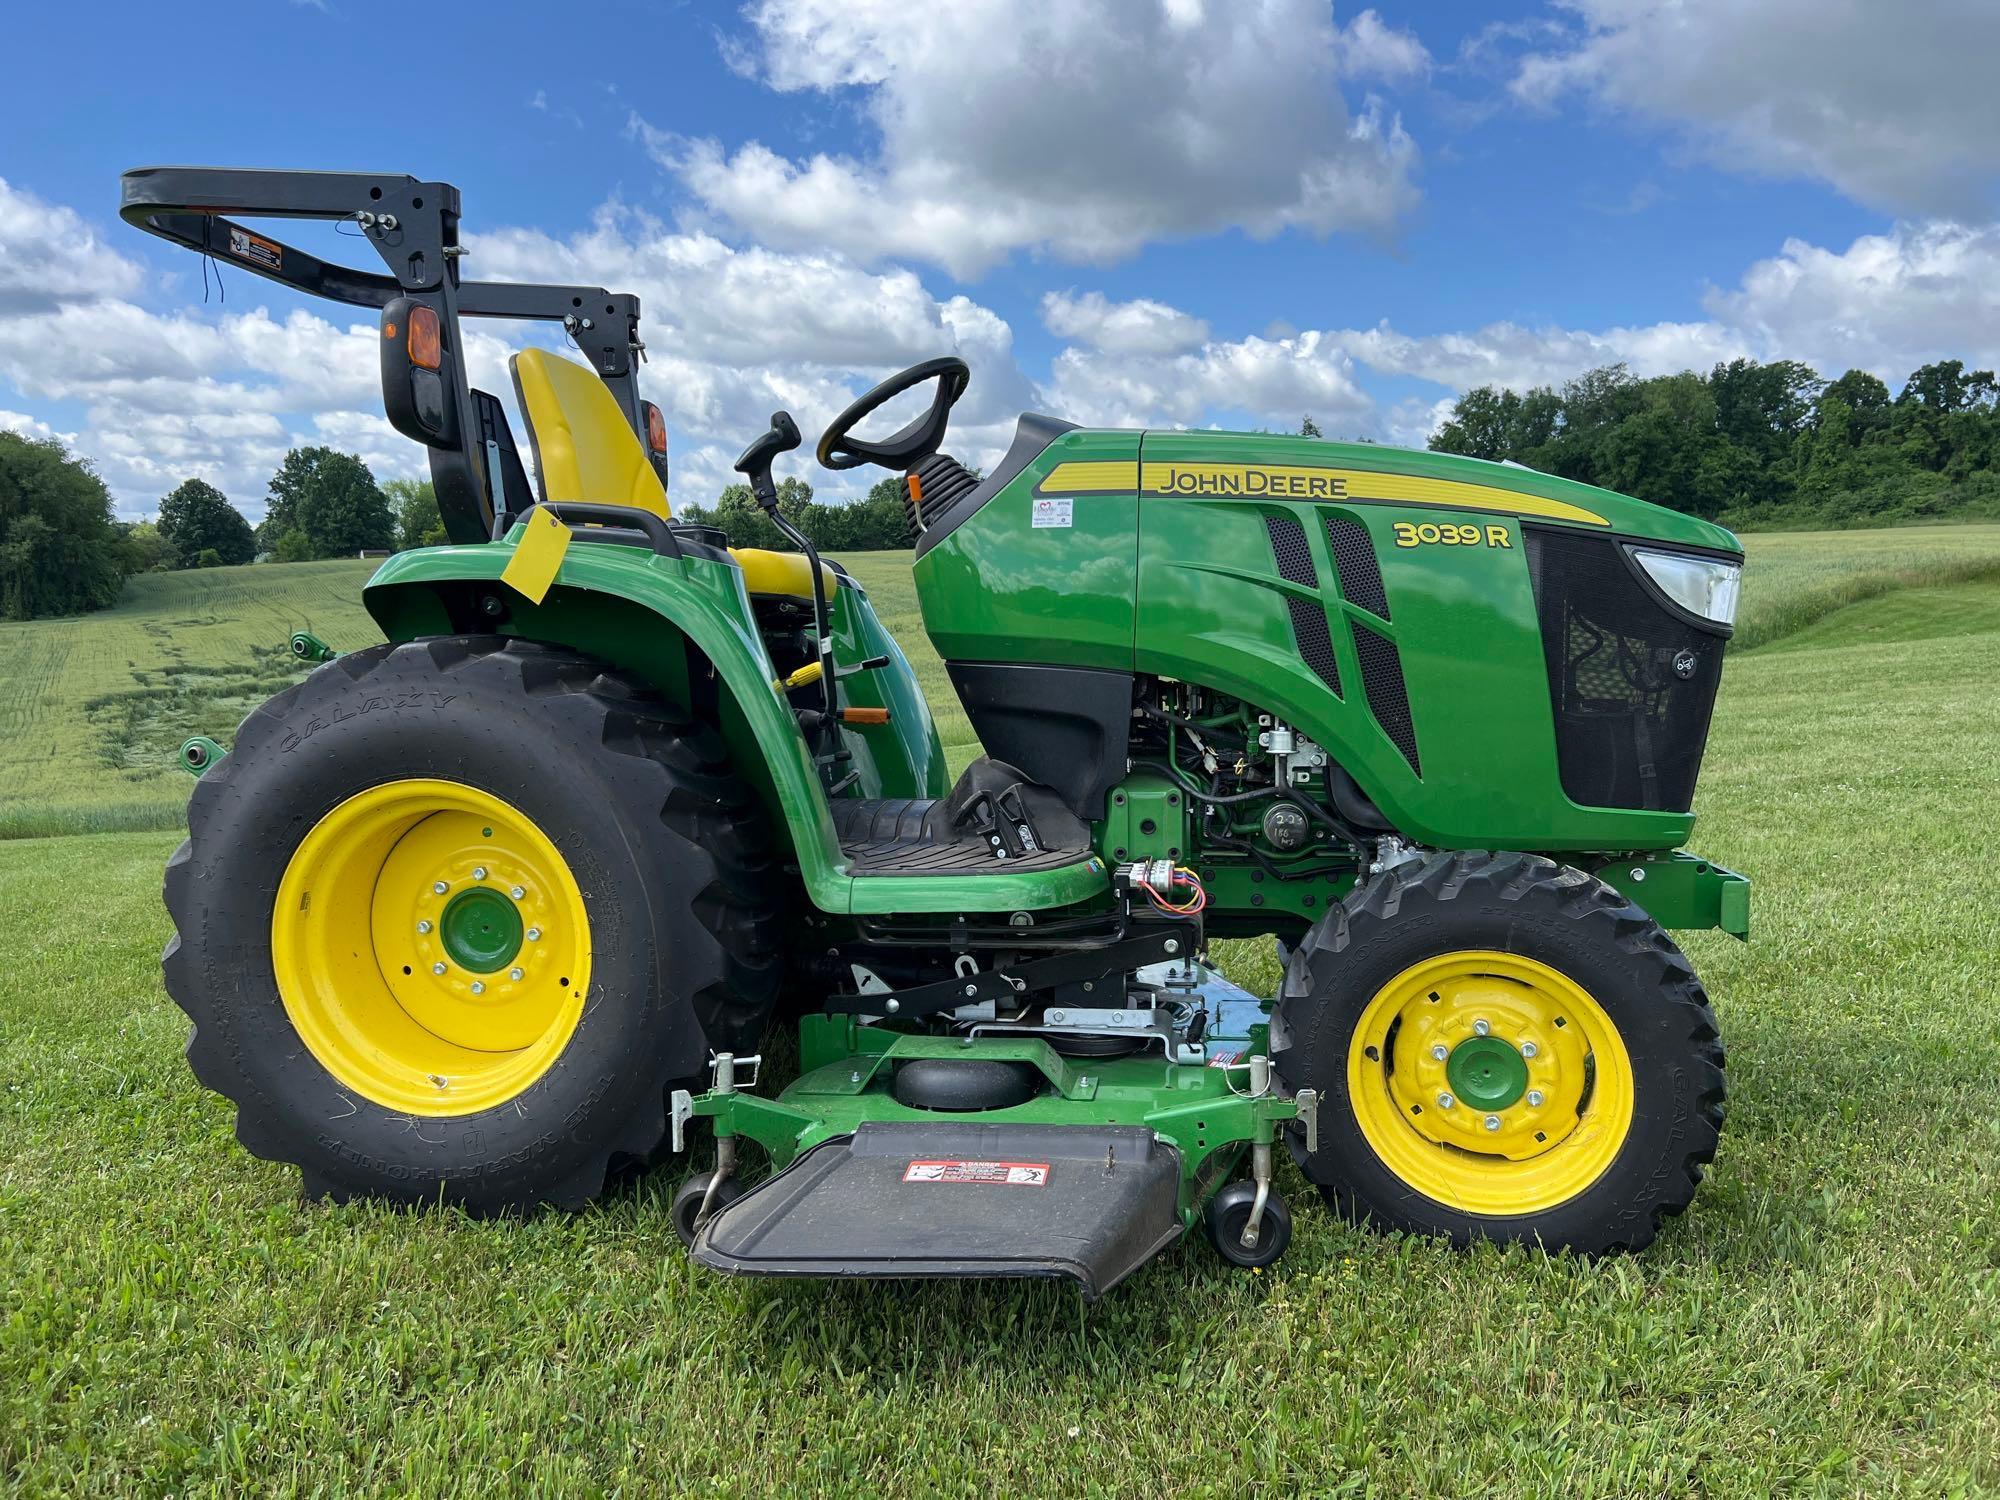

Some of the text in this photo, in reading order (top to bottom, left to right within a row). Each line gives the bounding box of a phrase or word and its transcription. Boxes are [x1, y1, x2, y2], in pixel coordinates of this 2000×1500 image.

[1160, 469, 1348, 497] JOHN DEERE
[1393, 521, 1513, 549] 3039 R
[281, 692, 457, 753] GALAXY
[1616, 1066, 1690, 1230] GALAXY
